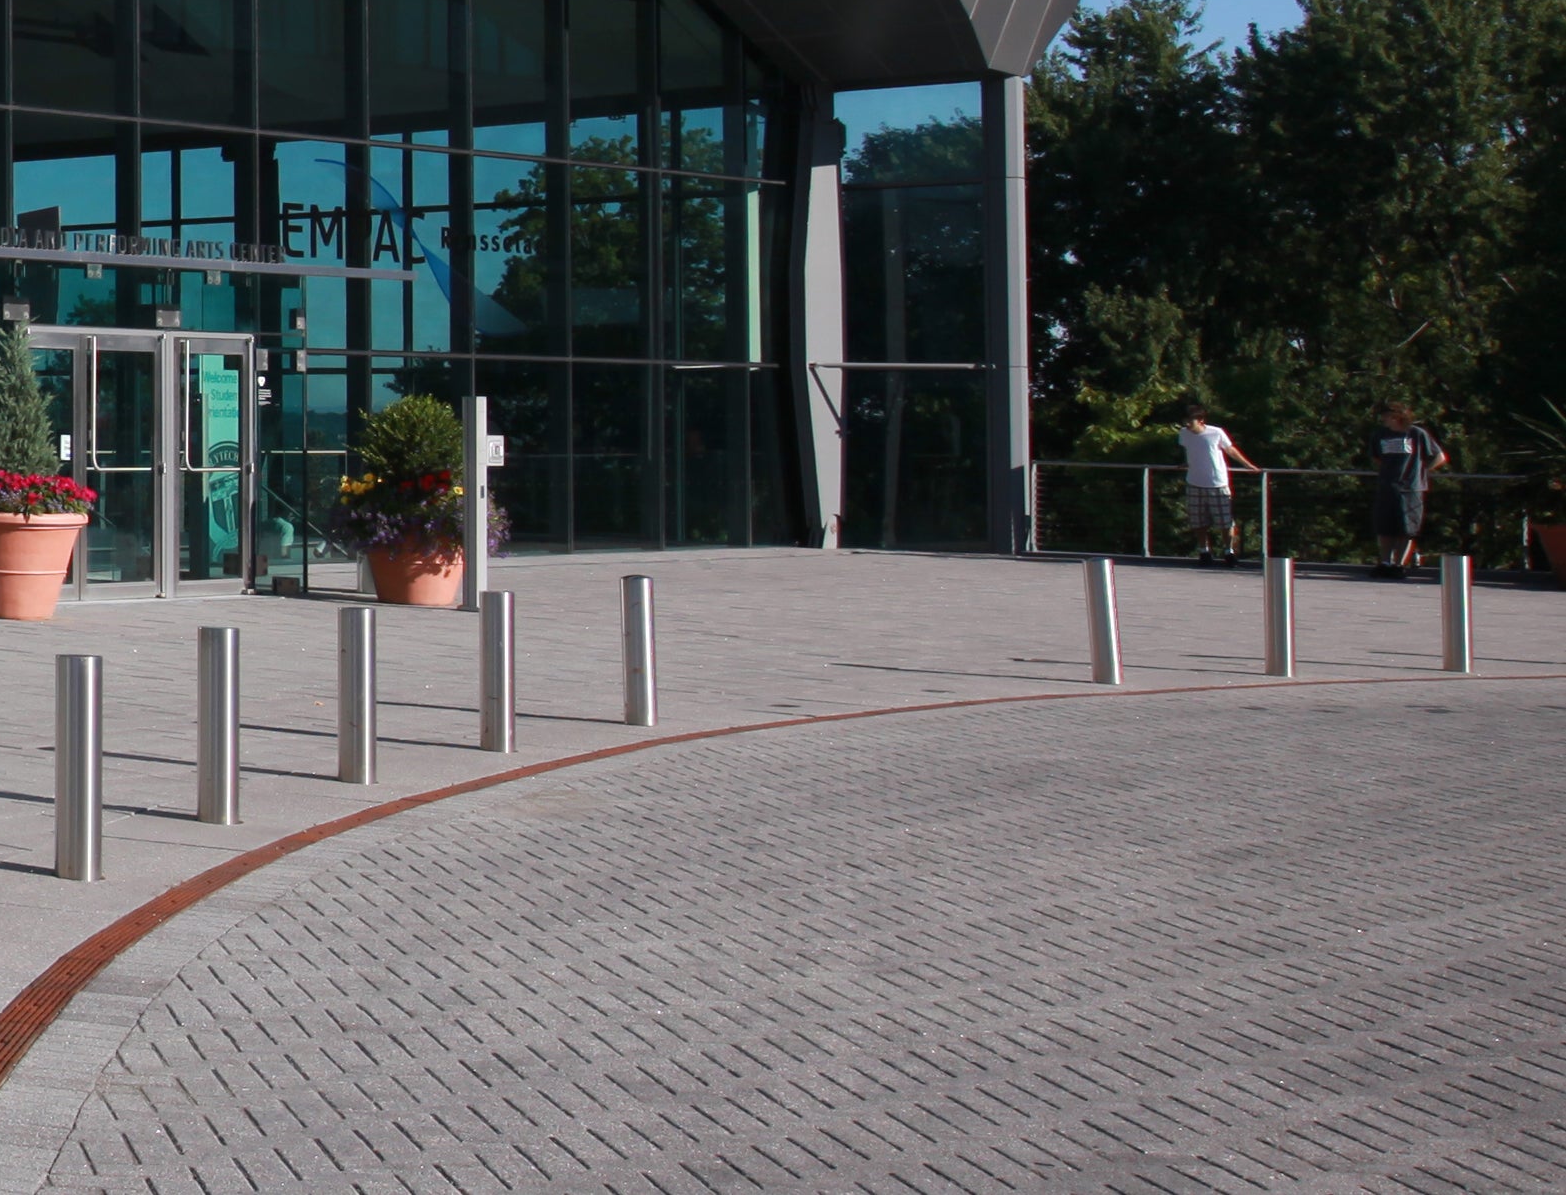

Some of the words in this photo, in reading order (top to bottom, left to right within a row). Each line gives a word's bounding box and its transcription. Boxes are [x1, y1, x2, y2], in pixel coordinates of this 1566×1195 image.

[35, 229, 66, 251] AND
[74, 232, 181, 258] PERFORMING
[185, 240, 224, 260] ARTS
[230, 241, 287, 263] CENTER
[282, 202, 427, 265] EMAC
